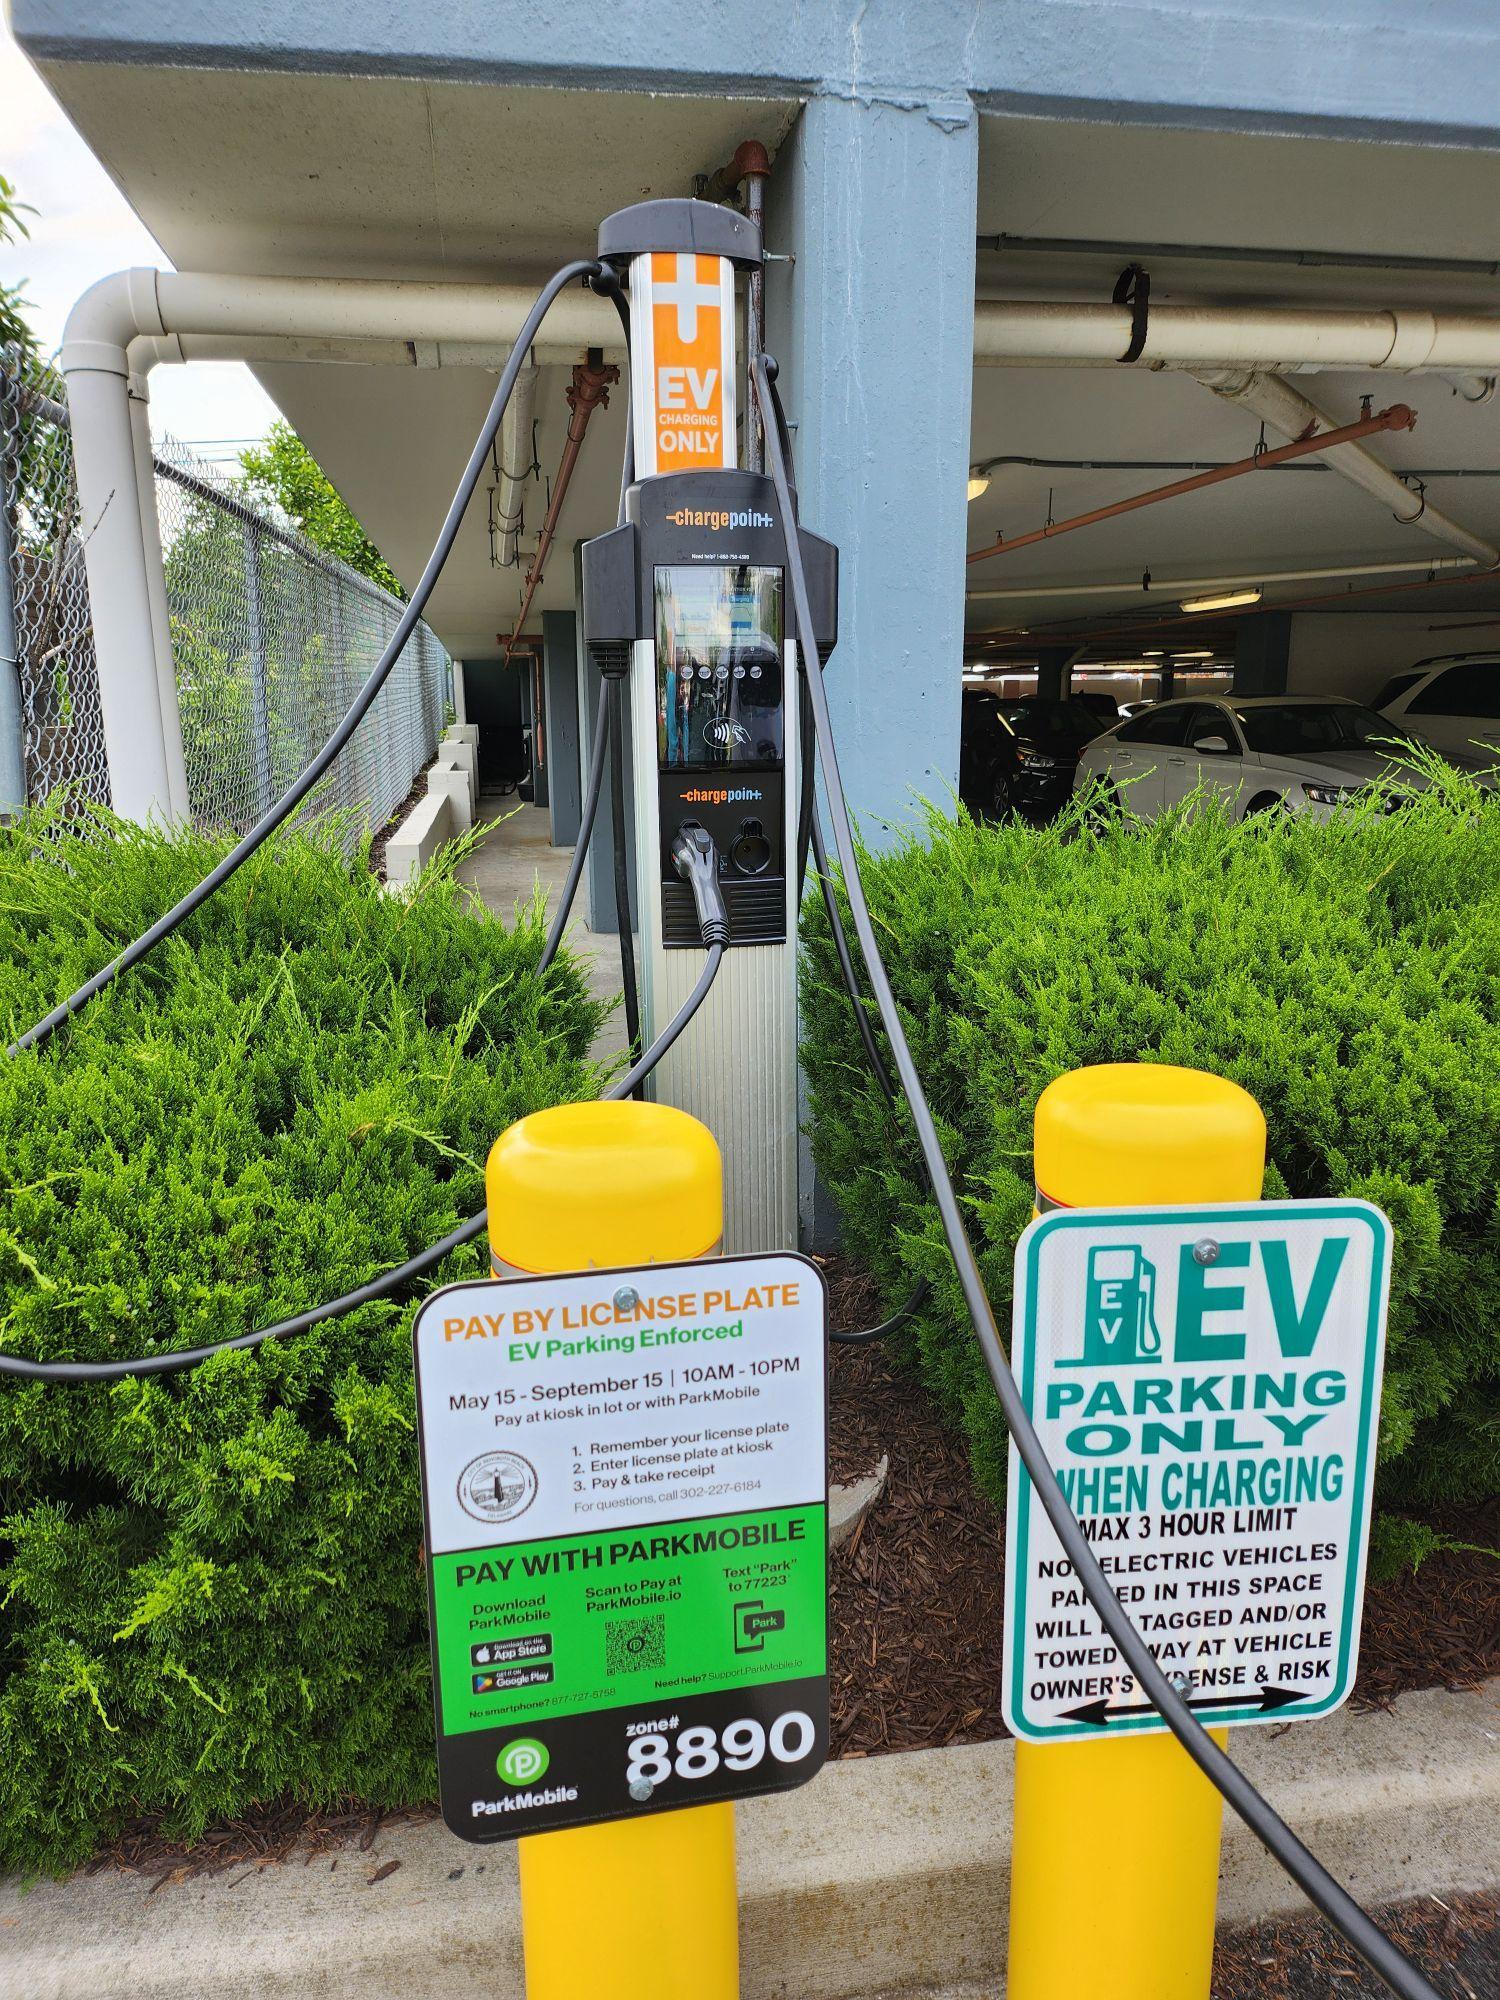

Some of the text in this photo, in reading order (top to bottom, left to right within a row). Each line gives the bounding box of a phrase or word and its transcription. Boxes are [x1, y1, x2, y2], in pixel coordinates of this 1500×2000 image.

[658, 367, 718, 410] EV
[659, 414, 718, 426] CHARGING
[659, 430, 720, 453] ONLY
[444, 1284, 800, 1342] PAY BY LICENSE PLATE
[1173, 1237, 1350, 1362] EV
[508, 1321, 743, 1362] EV Parking Enforced
[449, 1394, 490, 1411] May
[494, 1389, 516, 1405] 15
[531, 1377, 638, 1403] September
[643, 1372, 663, 1388] 15
[682, 1364, 734, 1383] 10AM
[750, 1357, 800, 1376] 10PM
[1046, 1370, 1347, 1419] PARKING
[495, 1386, 760, 1428] Pay at kiosk in lot or with ParkMobile
[572, 1421, 790, 1456] 1. Remember your license plate
[1066, 1414, 1328, 1457] ONLY
[573, 1440, 773, 1474] 2. Enter license plate at kiosk
[574, 1464, 716, 1492] 3. Pay & take receipt
[1056, 1454, 1344, 1515] WHEN CHARGING
[574, 1480, 762, 1513] For questions, call 302-227-6184
[1079, 1508, 1298, 1542] MAX 3 HOUR LIMIT
[456, 1519, 806, 1588] PAY WITH PARKMOBILE
[1223, 1543, 1337, 1567] VEHICLES
[586, 1574, 682, 1598] Scan to Pay at
[722, 1566, 751, 1579] Text
[729, 1582, 742, 1592] to
[473, 1594, 546, 1616] Download
[586, 1591, 682, 1612] ParkMobile.io
[1051, 1574, 1322, 1608] PAED IN THIS SPACE
[469, 1610, 550, 1631] ParkMobile
[752, 1616, 778, 1629] Park
[1036, 1619, 1092, 1639] WILL
[1140, 1610, 1233, 1632] TAGGED
[1240, 1602, 1327, 1625] AND/OR
[494, 1644, 547, 1660] App Store
[1035, 1631, 1332, 1670] TOWED WAY AT VEHICLE
[496, 1671, 548, 1687] Google Play
[655, 1660, 803, 1688] Need help? Support.ParkMobile.io
[1030, 1675, 1134, 1700] OWNER'S
[1254, 1666, 1269, 1682] &
[1278, 1659, 1332, 1681] RISK
[469, 1710, 483, 1719] No
[485, 1699, 549, 1716] smartphone?
[625, 1715, 680, 1737] zone#
[626, 1710, 817, 1788] 8890
[472, 1785, 578, 1818] ParkMobile
